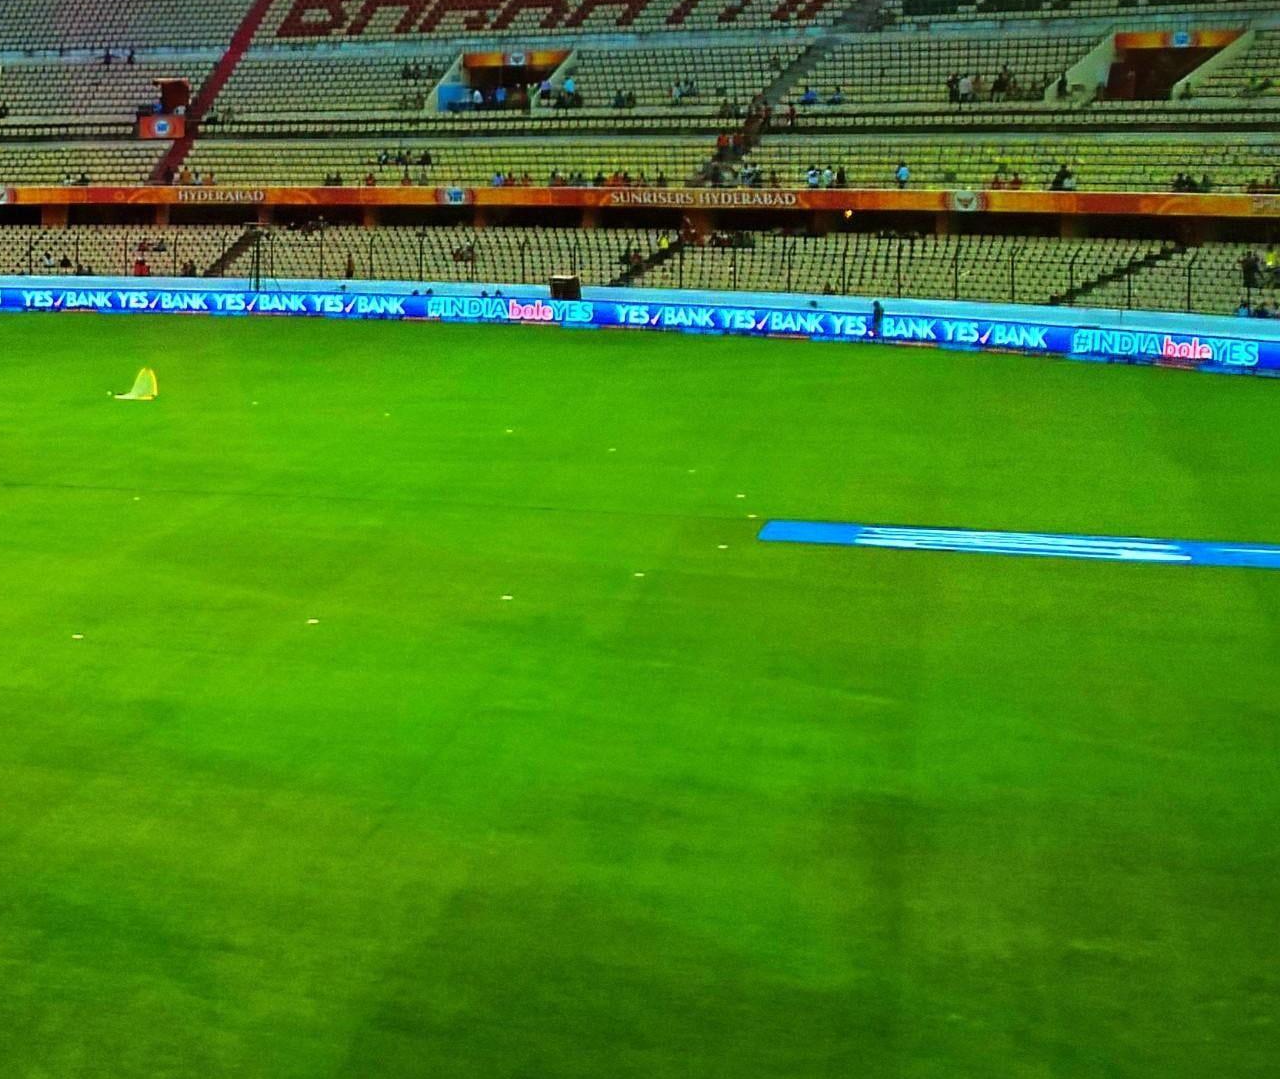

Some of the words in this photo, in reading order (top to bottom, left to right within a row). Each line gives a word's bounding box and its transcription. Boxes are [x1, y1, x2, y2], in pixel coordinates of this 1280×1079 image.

[177, 189, 266, 202] HYDERABAD
[610, 191, 694, 205] SUNRISERS
[698, 191, 797, 205] HYDERABAD
[22, 289, 54, 307] YES
[68, 290, 112, 307] BANK
[117, 291, 149, 309] YES
[161, 292, 208, 310] BANK
[214, 293, 247, 310] YES
[259, 293, 307, 311] BANK
[311, 295, 345, 312] YES
[357, 295, 405, 314] BANK
[617, 303, 650, 324] YES
[664, 306, 715, 327] BANK
[720, 308, 756, 330] YES
[770, 311, 824, 333] BANK
[831, 314, 867, 337] YES
[882, 317, 936, 340] BANK
[943, 321, 979, 344] YES
[994, 324, 1048, 348] BANK
